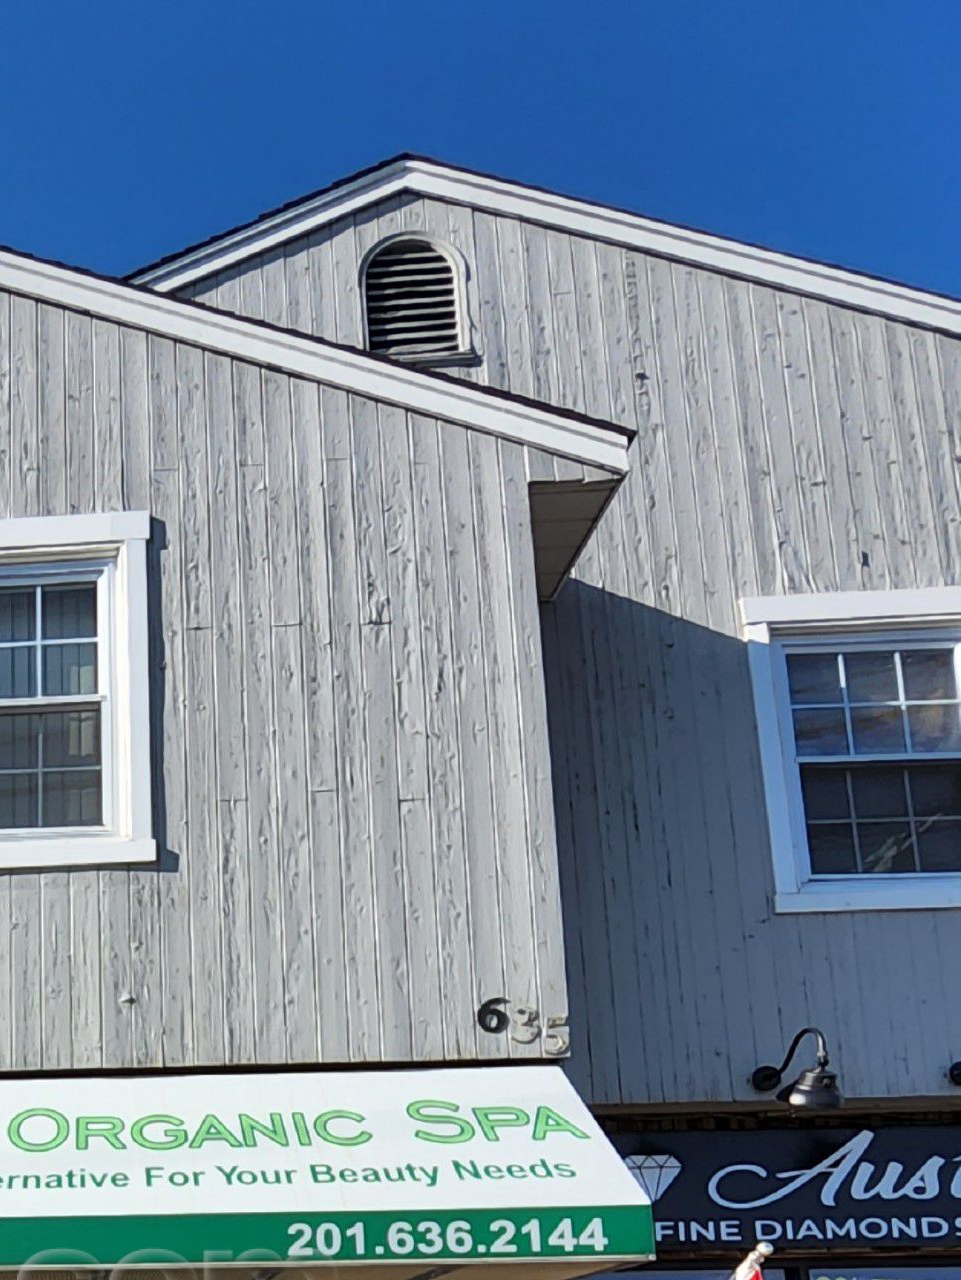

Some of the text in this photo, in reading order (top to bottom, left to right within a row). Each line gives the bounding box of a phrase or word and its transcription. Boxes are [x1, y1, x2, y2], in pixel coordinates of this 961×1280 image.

[477, 997, 572, 1056] 635
[145, 1166, 205, 1187] For
[216, 1164, 299, 1186] Your
[311, 1163, 440, 1187] Beauty
[453, 1158, 578, 1181] Needs
[287, 1217, 608, 1256] 201.636.2144
[655, 1220, 742, 1242] FINE
